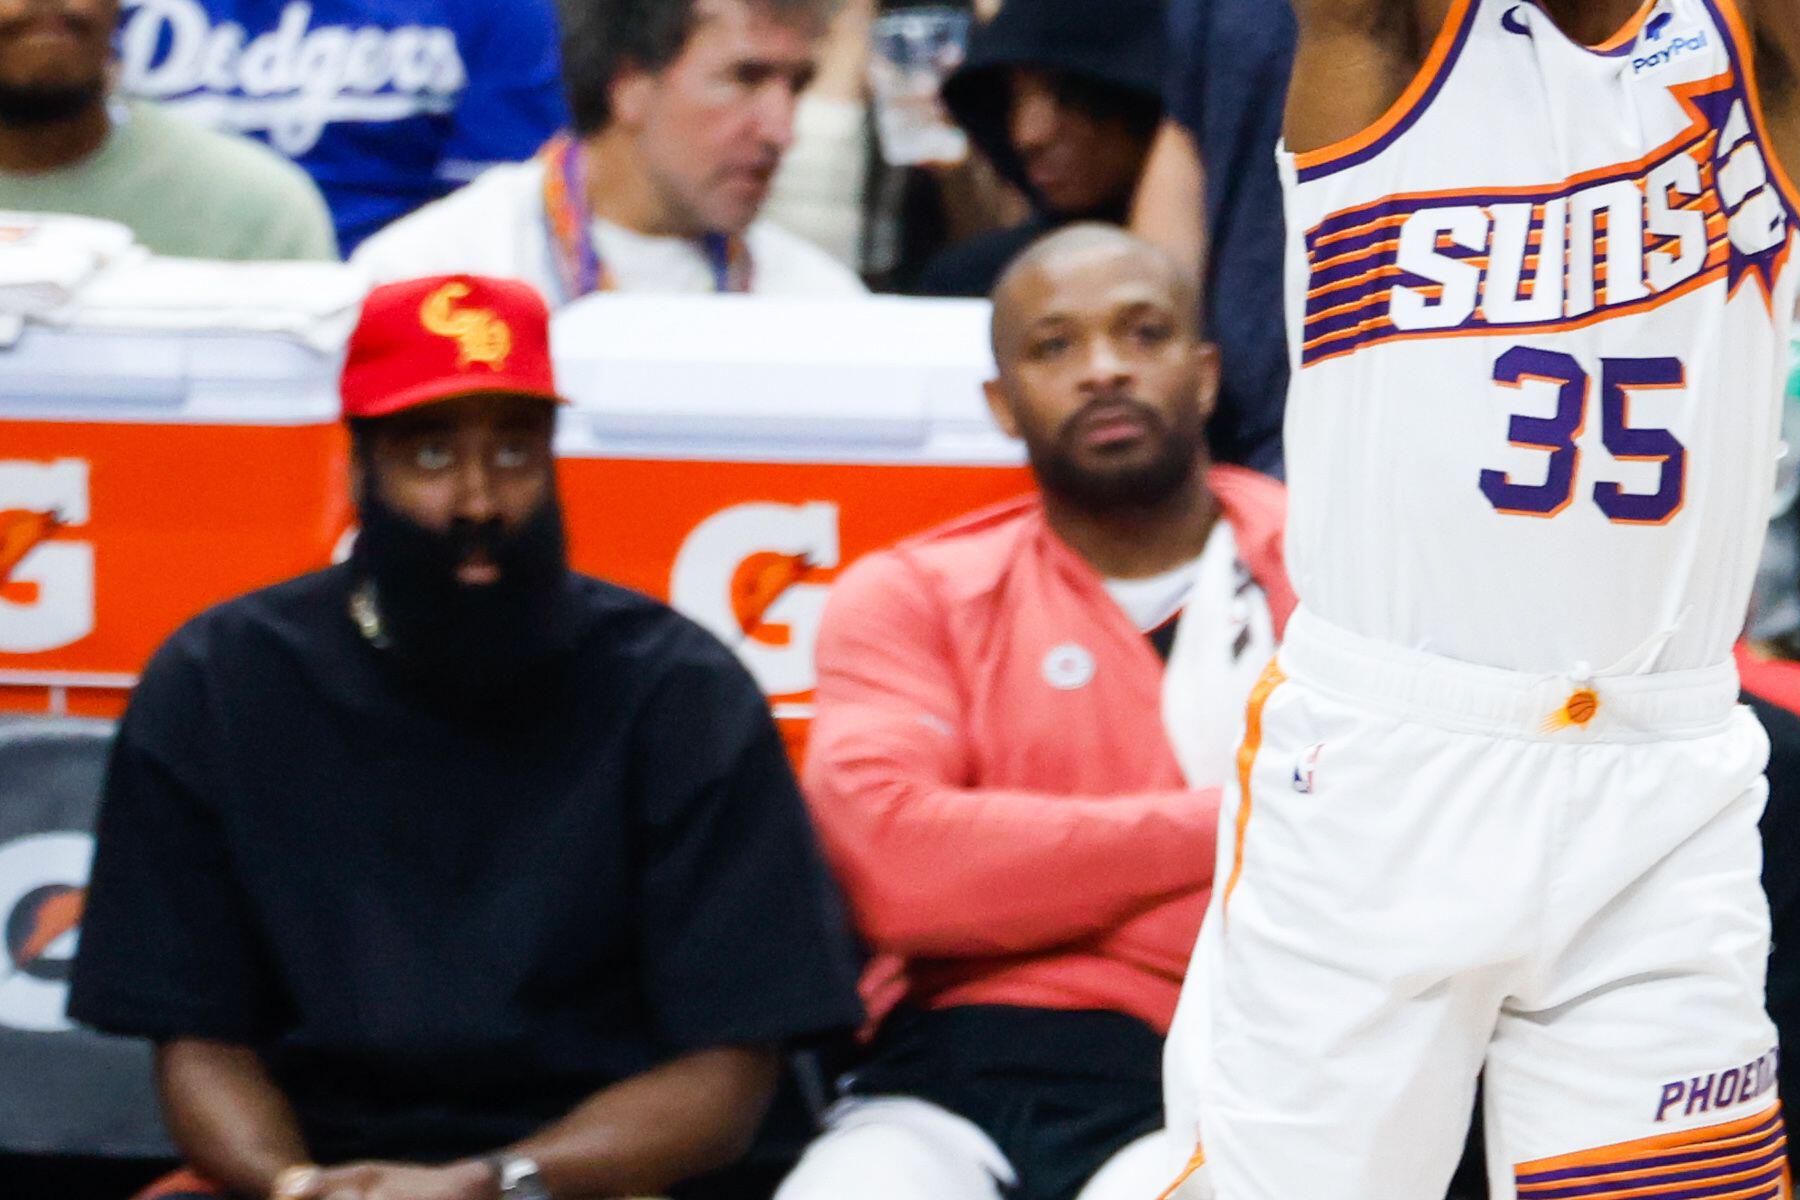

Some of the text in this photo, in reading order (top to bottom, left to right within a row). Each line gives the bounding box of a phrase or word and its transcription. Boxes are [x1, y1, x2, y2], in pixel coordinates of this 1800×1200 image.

[1632, 30, 1708, 75] PayPal
[1388, 152, 1709, 331] SUNS
[1478, 345, 1688, 527] 35
[669, 500, 840, 696] G
